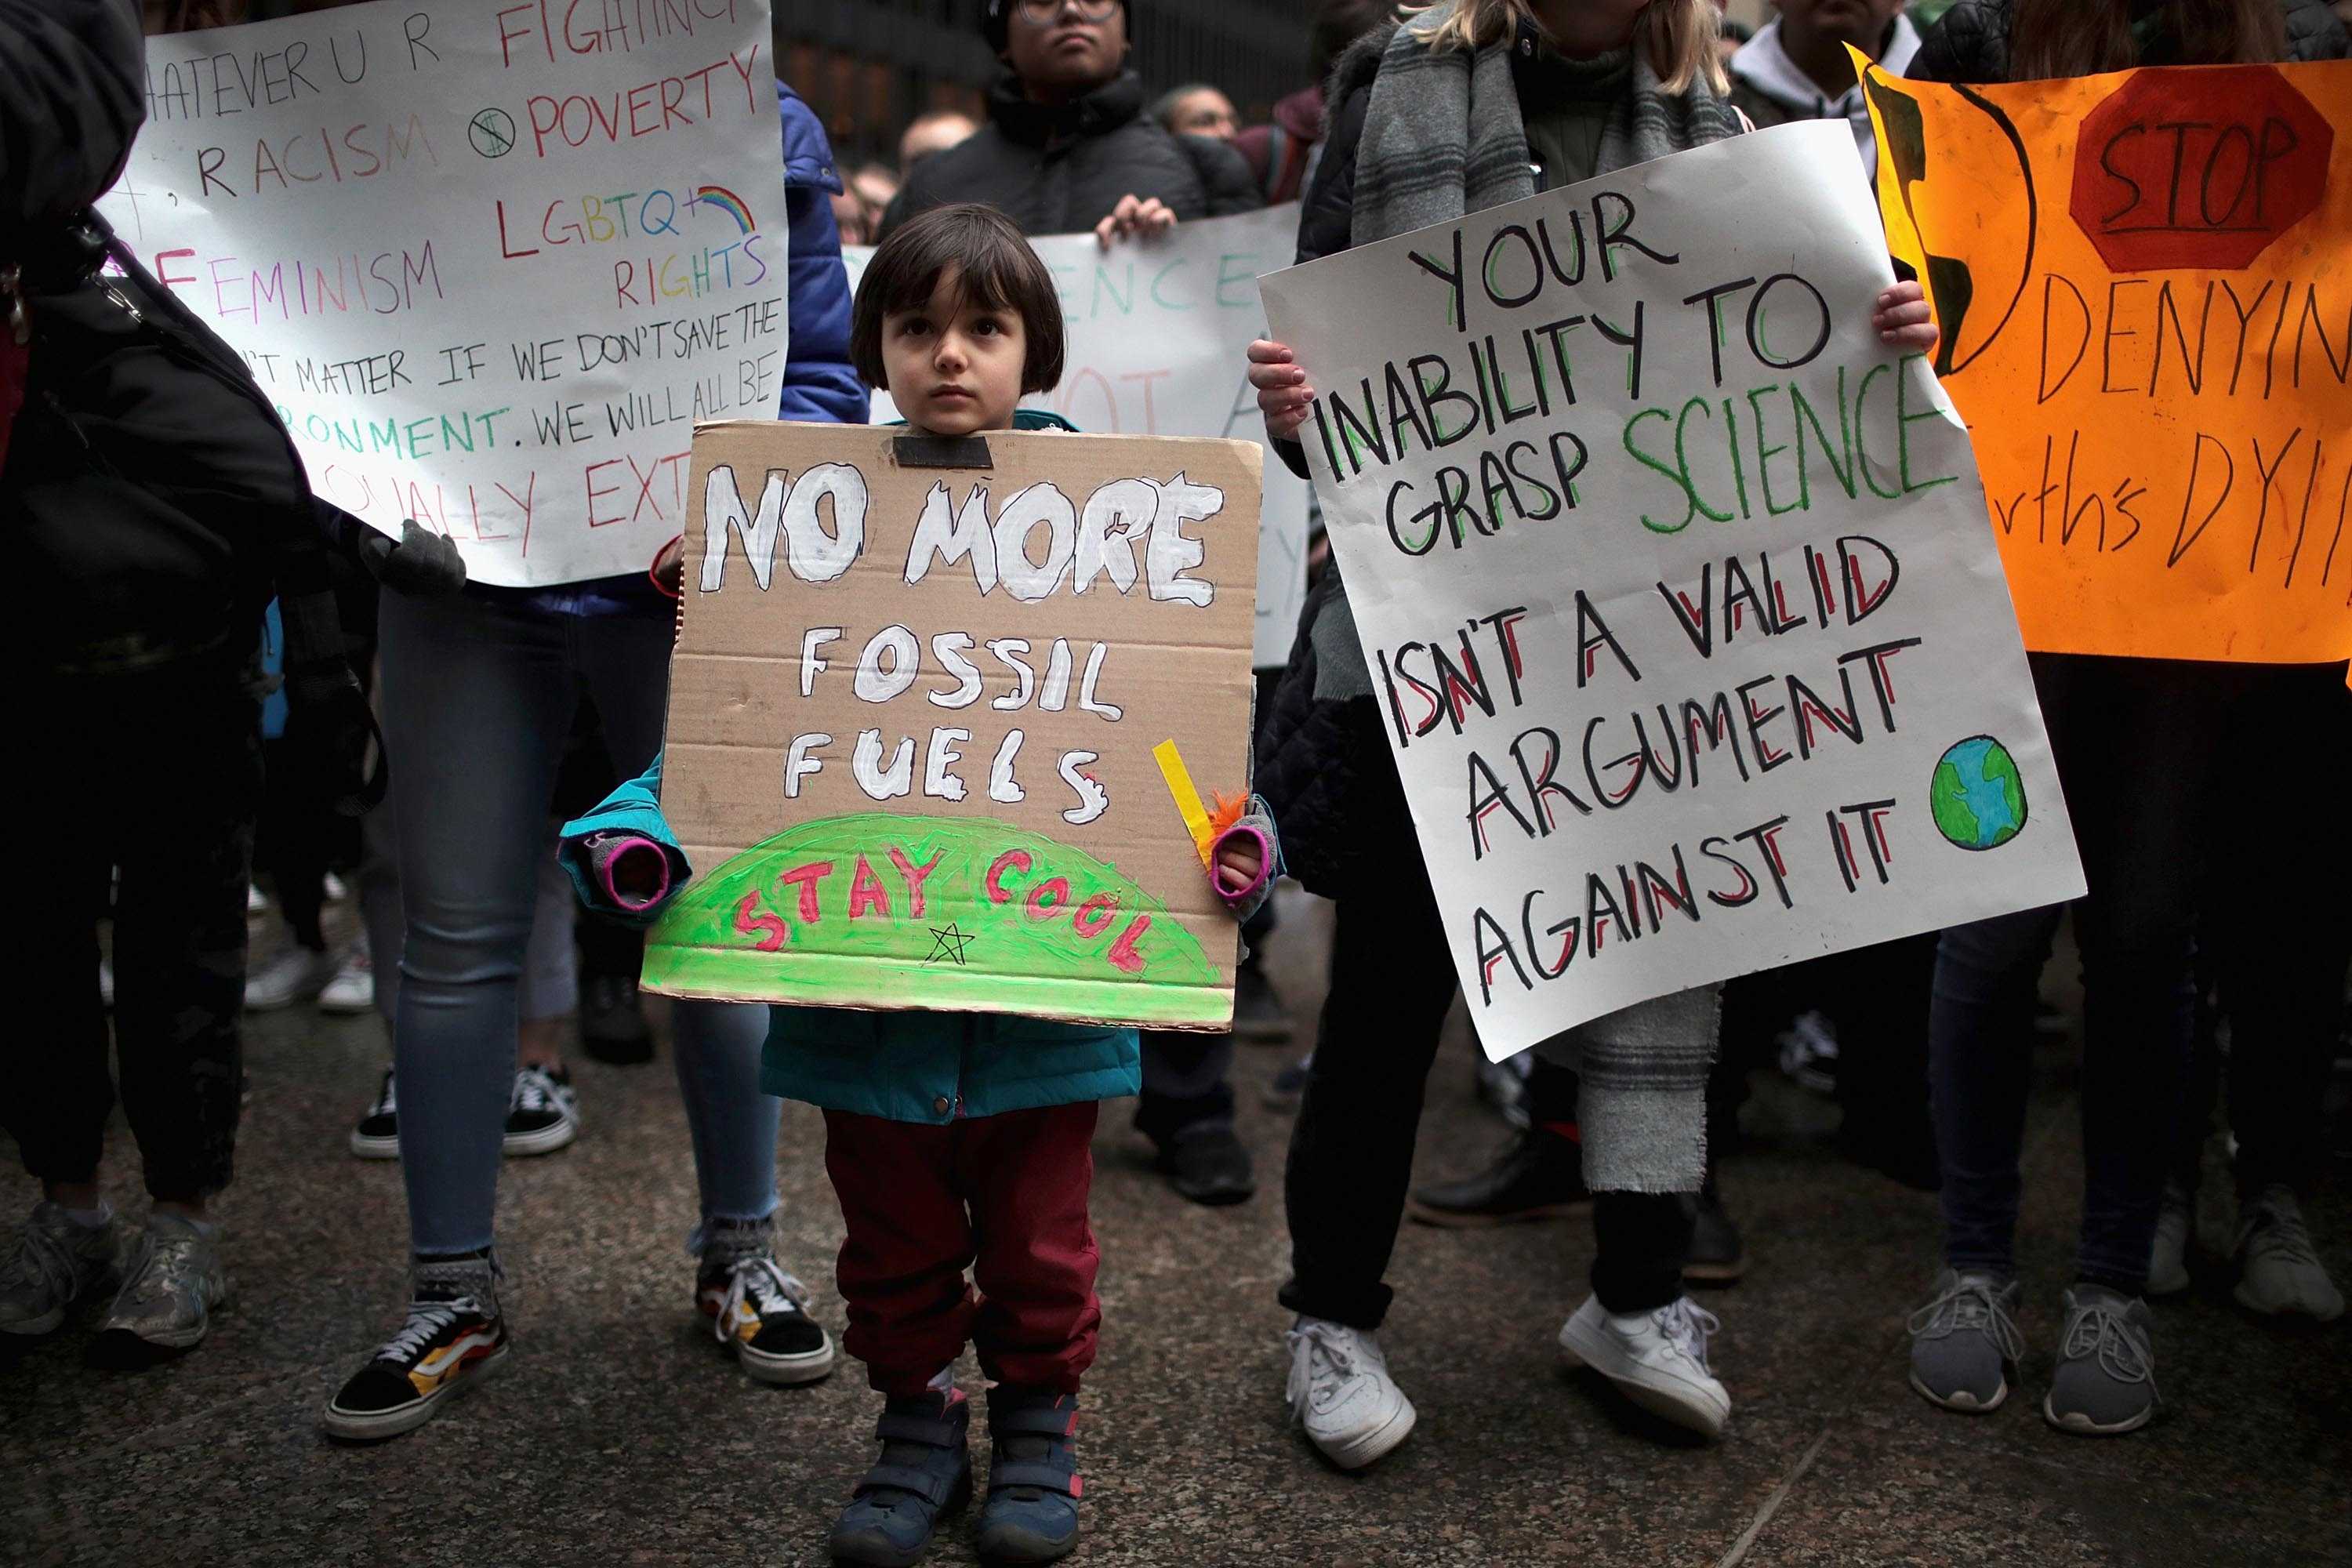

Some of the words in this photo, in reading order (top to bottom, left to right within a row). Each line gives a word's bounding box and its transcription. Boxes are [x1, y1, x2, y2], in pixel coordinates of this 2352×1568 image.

[145, 42, 320, 122] HATEVER
[329, 29, 366, 85] U
[403, 12, 441, 71] R
[197, 113, 438, 198] RACISM
[527, 44, 759, 158] POVERTY
[2100, 116, 2299, 227] STOP
[155, 238, 443, 325] FEMINISM
[615, 235, 767, 309] RIGHTS
[1407, 191, 1680, 333] YOUR
[295, 350, 412, 394] MATTER
[438, 343, 487, 387] IF
[511, 338, 565, 382] WE
[577, 321, 673, 372] DON'T
[673, 313, 731, 360] SAVE
[735, 298, 783, 344] THE
[1312, 299, 1645, 484] INABILITY
[1683, 272, 1832, 388] TO
[2038, 272, 2352, 405] DENYIN
[276, 404, 522, 460] RONMENT.
[532, 400, 593, 446] WE
[607, 387, 687, 437] WILL
[693, 373, 730, 421] ALL
[739, 350, 778, 406] BE
[1385, 431, 1589, 557] GRASP
[1622, 352, 1960, 535] SCIENCE
[586, 450, 691, 528] EXT
[699, 461, 869, 593] NO
[902, 470, 1225, 608] MORE
[799, 623, 1124, 723] FOSSIL
[1377, 604, 1529, 749] ISN'T
[1573, 589, 1642, 689] A
[1656, 535, 1901, 659] VALID
[783, 726, 1110, 826] FUELS
[1465, 636, 1922, 862] ARGUMENT
[731, 844, 948, 953] STAY
[985, 847, 1154, 975] COOL
[1472, 814, 1791, 1007] AGAINST
[1825, 797, 1896, 894] IT
